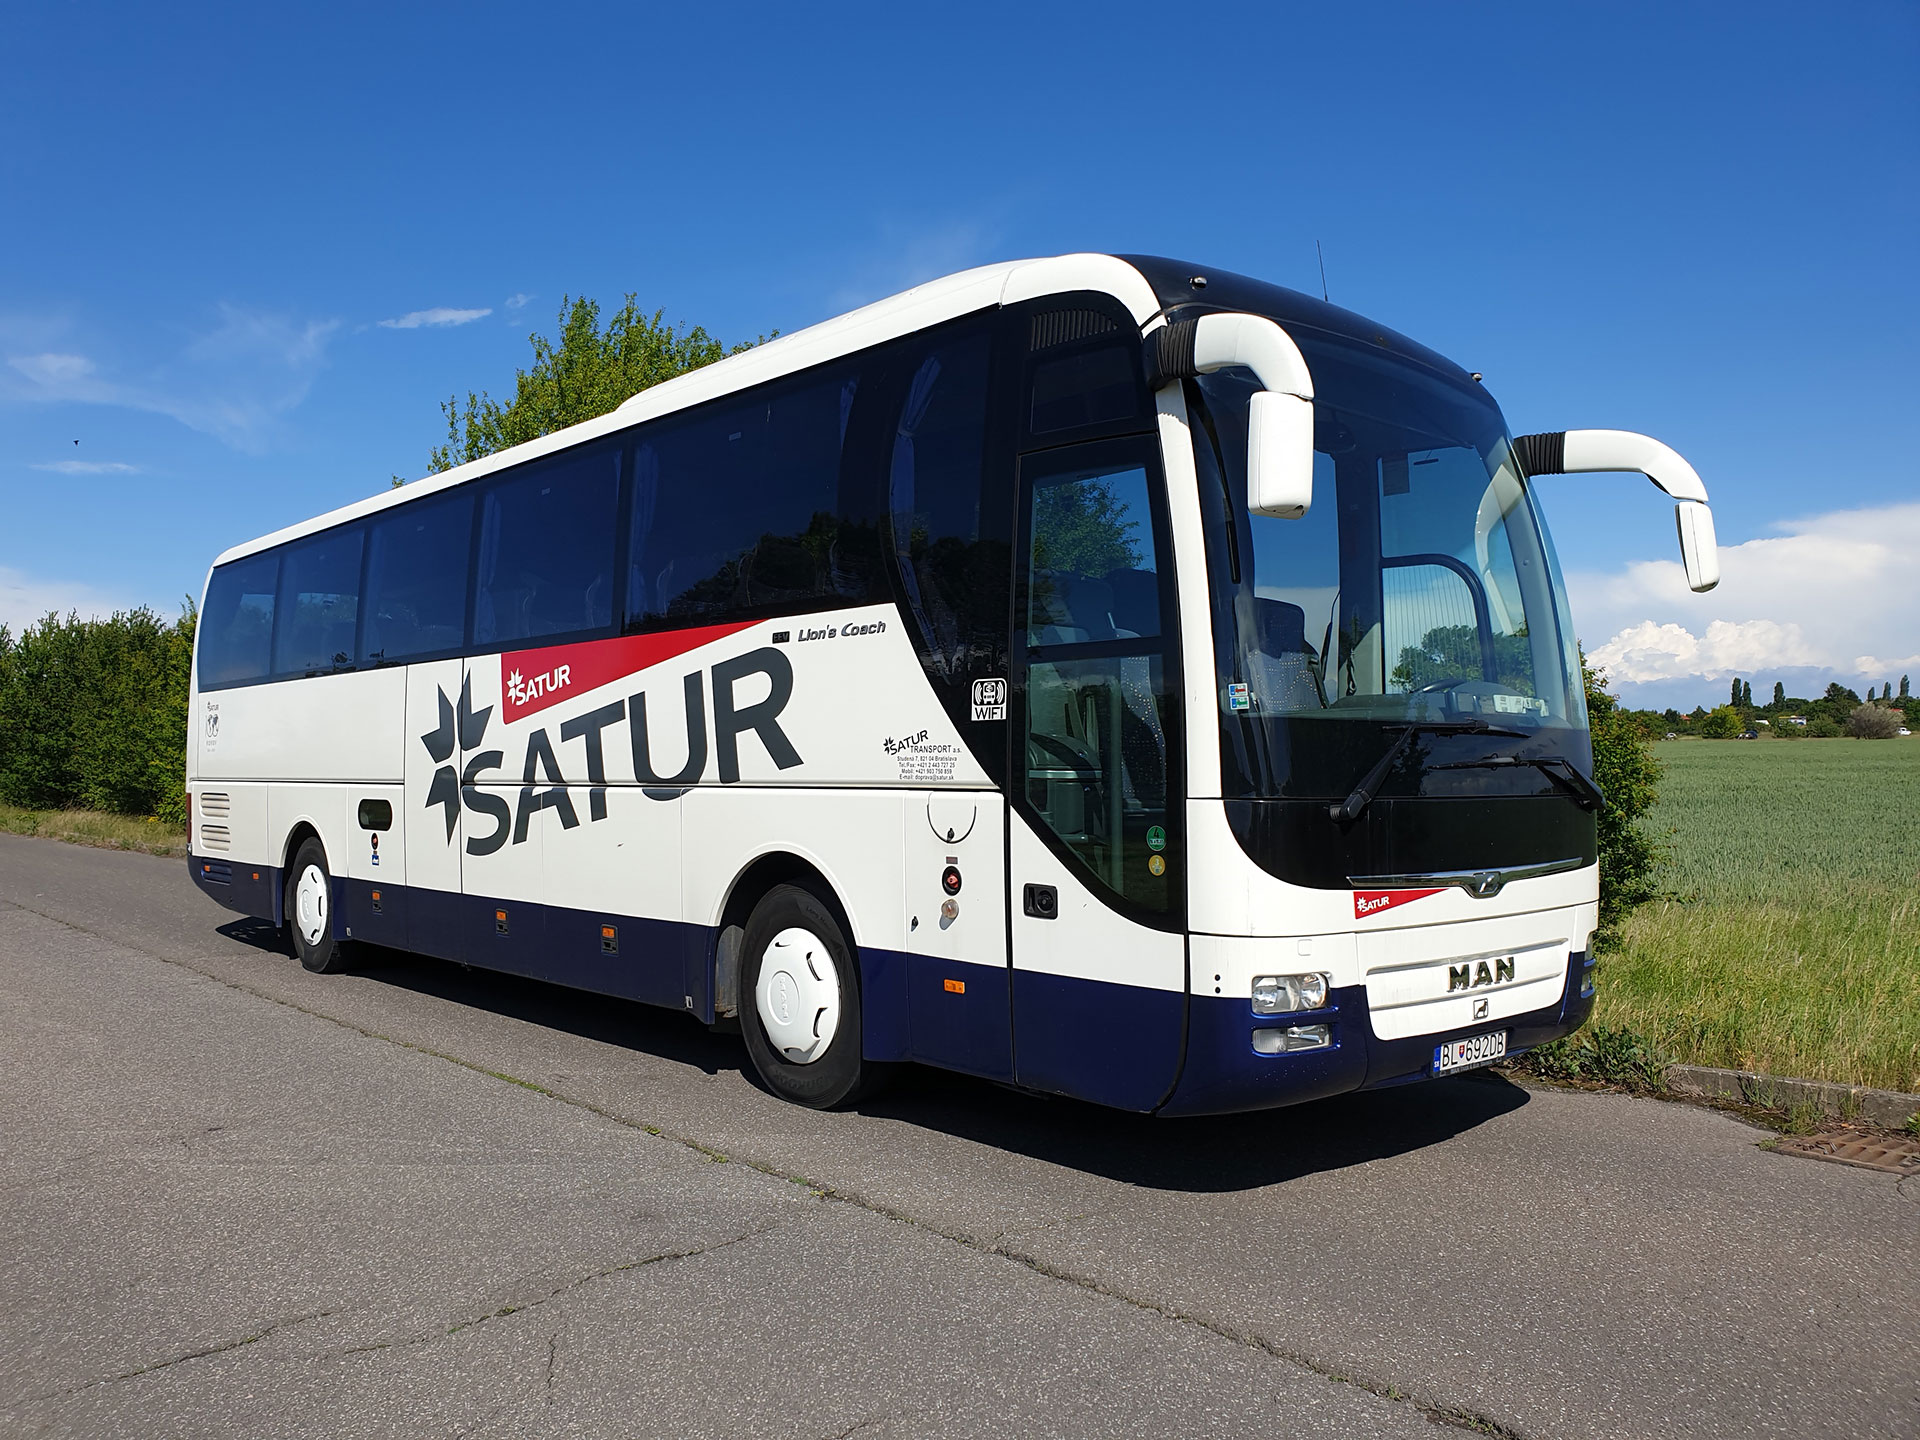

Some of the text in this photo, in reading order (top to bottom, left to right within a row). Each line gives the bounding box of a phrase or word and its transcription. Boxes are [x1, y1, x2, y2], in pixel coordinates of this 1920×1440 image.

[798, 620, 886, 642] Lion's Coach
[515, 664, 571, 706] SATUR
[974, 706, 1004, 720] WIFI
[462, 647, 804, 856] SATUR
[889, 729, 929, 755] SATUR
[910, 745, 952, 753] TRANSPORT
[1361, 896, 1390, 912] SATUR
[1447, 957, 1514, 992] MAN
[1442, 1033, 1503, 1067] BL 692DB
